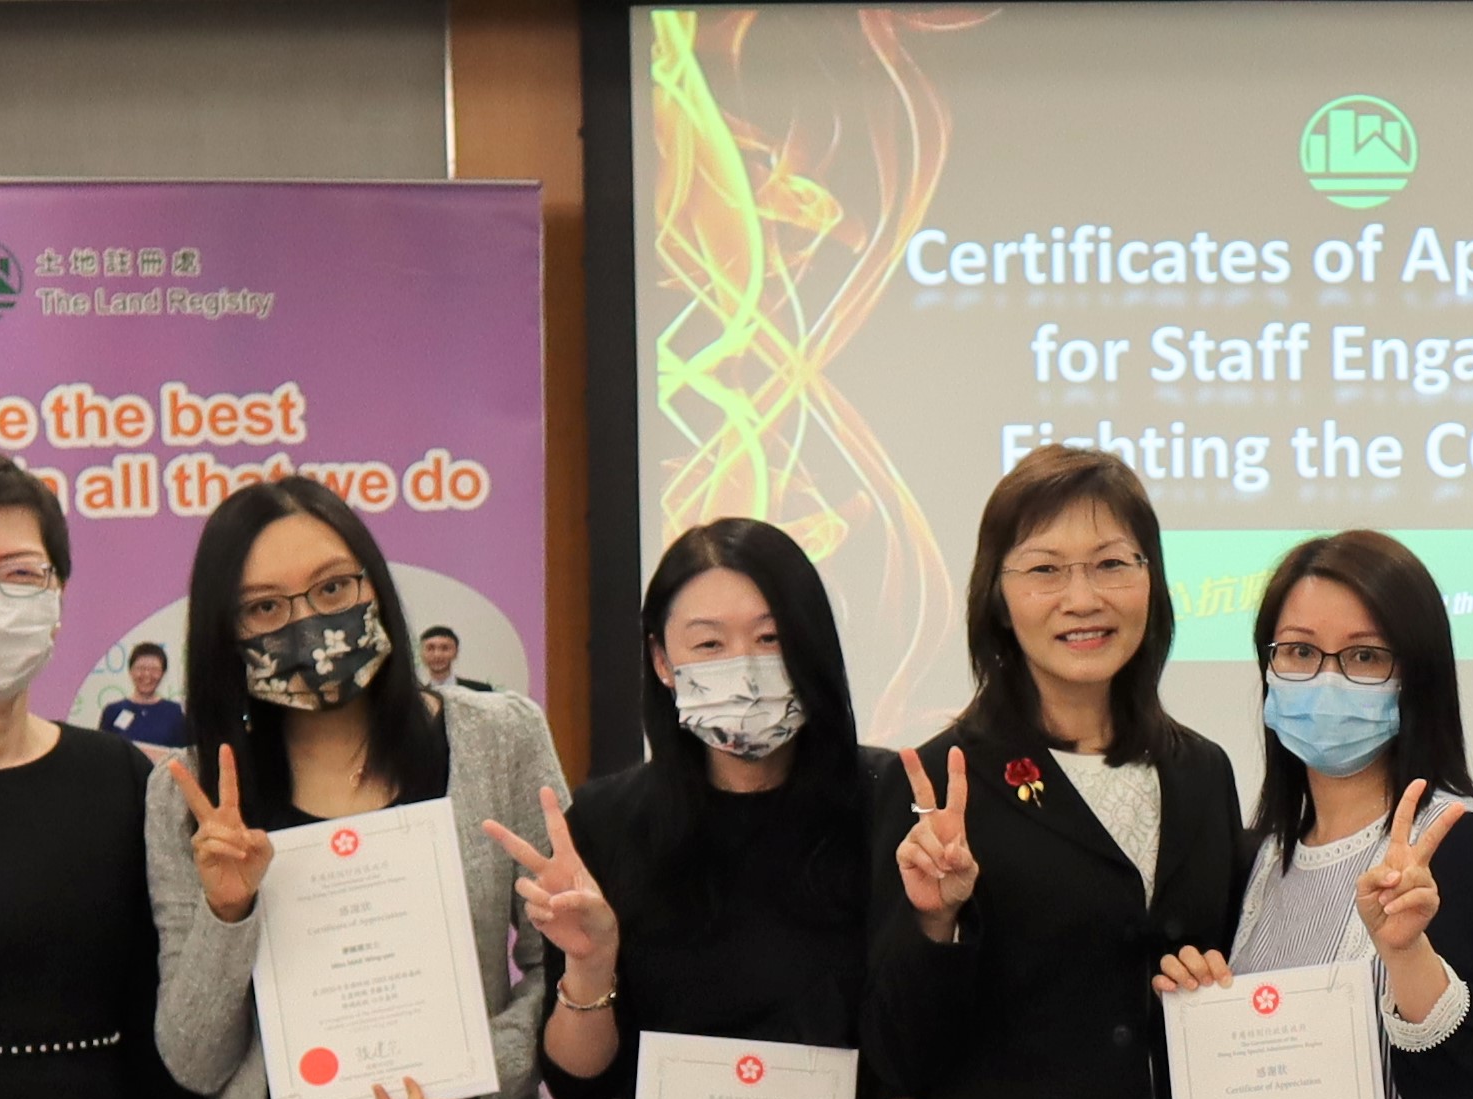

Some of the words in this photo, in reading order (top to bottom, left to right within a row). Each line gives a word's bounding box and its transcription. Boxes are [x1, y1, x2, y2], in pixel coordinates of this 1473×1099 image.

[35, 248, 201, 276] 土地註冊處
[906, 226, 1291, 285] Certificates
[1313, 225, 1383, 285] of
[36, 288, 91, 315] The
[95, 288, 161, 315] Land
[167, 288, 274, 319] Registry
[1031, 324, 1131, 383] for
[1150, 323, 1311, 383] Staff
[49, 390, 147, 440] the
[168, 388, 298, 438] best
[1001, 420, 1271, 492] Fhting
[1293, 421, 1403, 479] the
[83, 461, 150, 509] all
[410, 457, 482, 503] do
